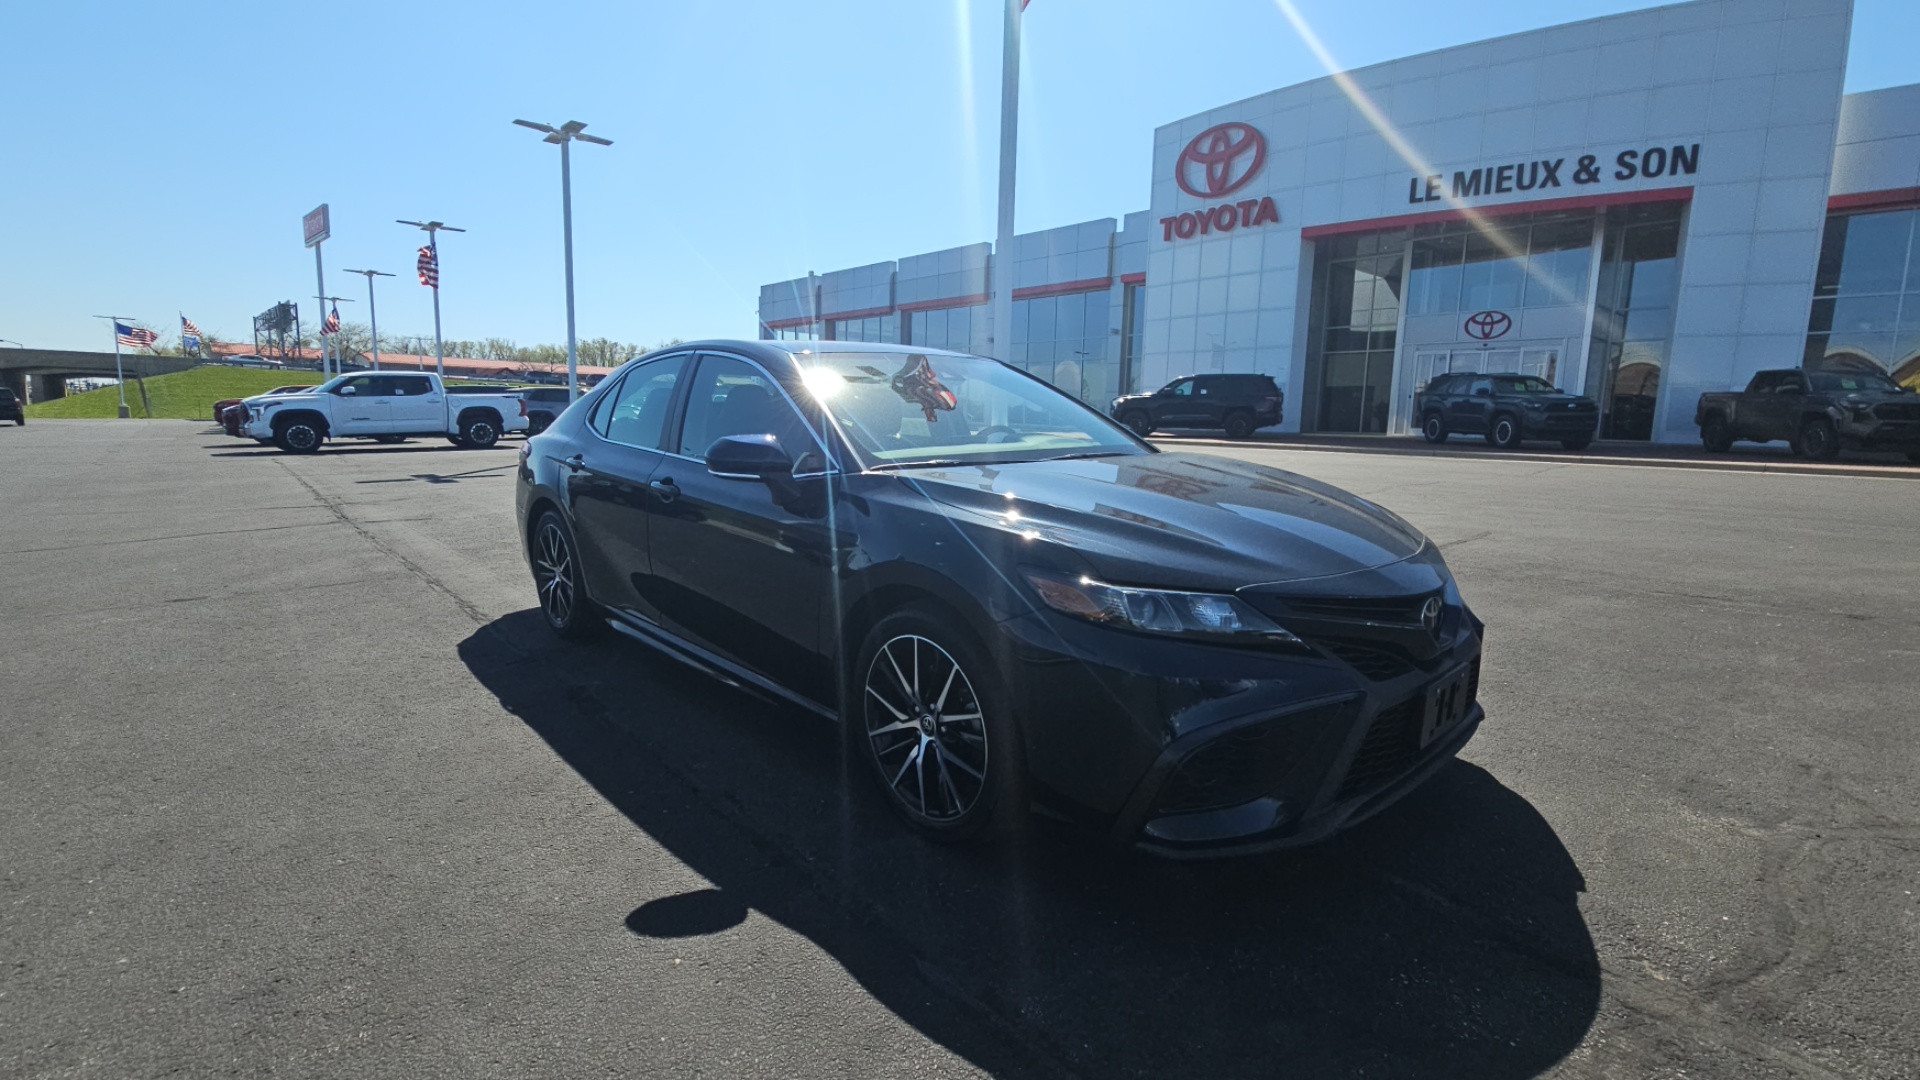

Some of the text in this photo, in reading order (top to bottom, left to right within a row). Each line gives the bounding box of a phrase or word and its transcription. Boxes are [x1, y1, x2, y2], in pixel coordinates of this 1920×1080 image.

[1409, 143, 1700, 204] LE MIEUX & SON
[1160, 196, 1279, 242] TOYOTA
